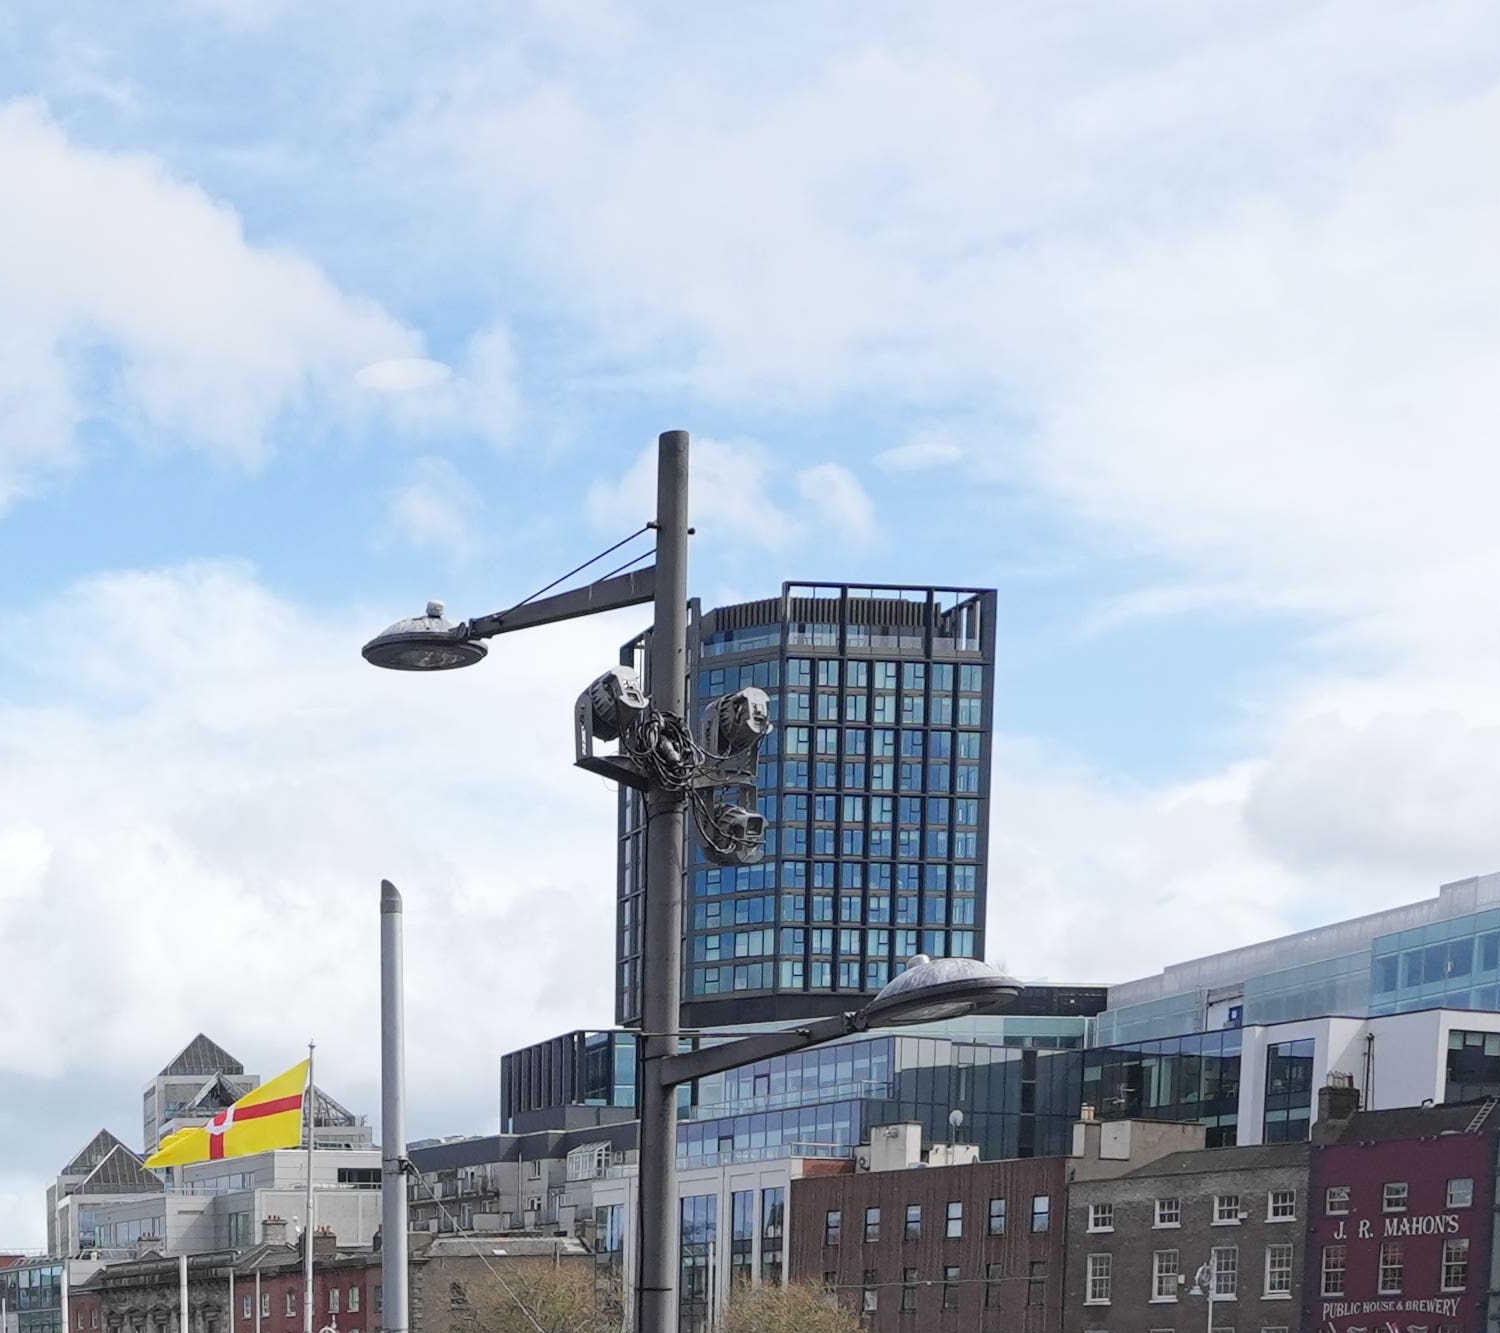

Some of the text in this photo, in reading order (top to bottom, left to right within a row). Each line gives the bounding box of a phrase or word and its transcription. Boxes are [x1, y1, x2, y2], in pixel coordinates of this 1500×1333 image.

[1334, 1215, 1460, 1239] J. R. MAHON'S
[1323, 1297, 1461, 1321] PUBLIC HOUSE & BREWERY
